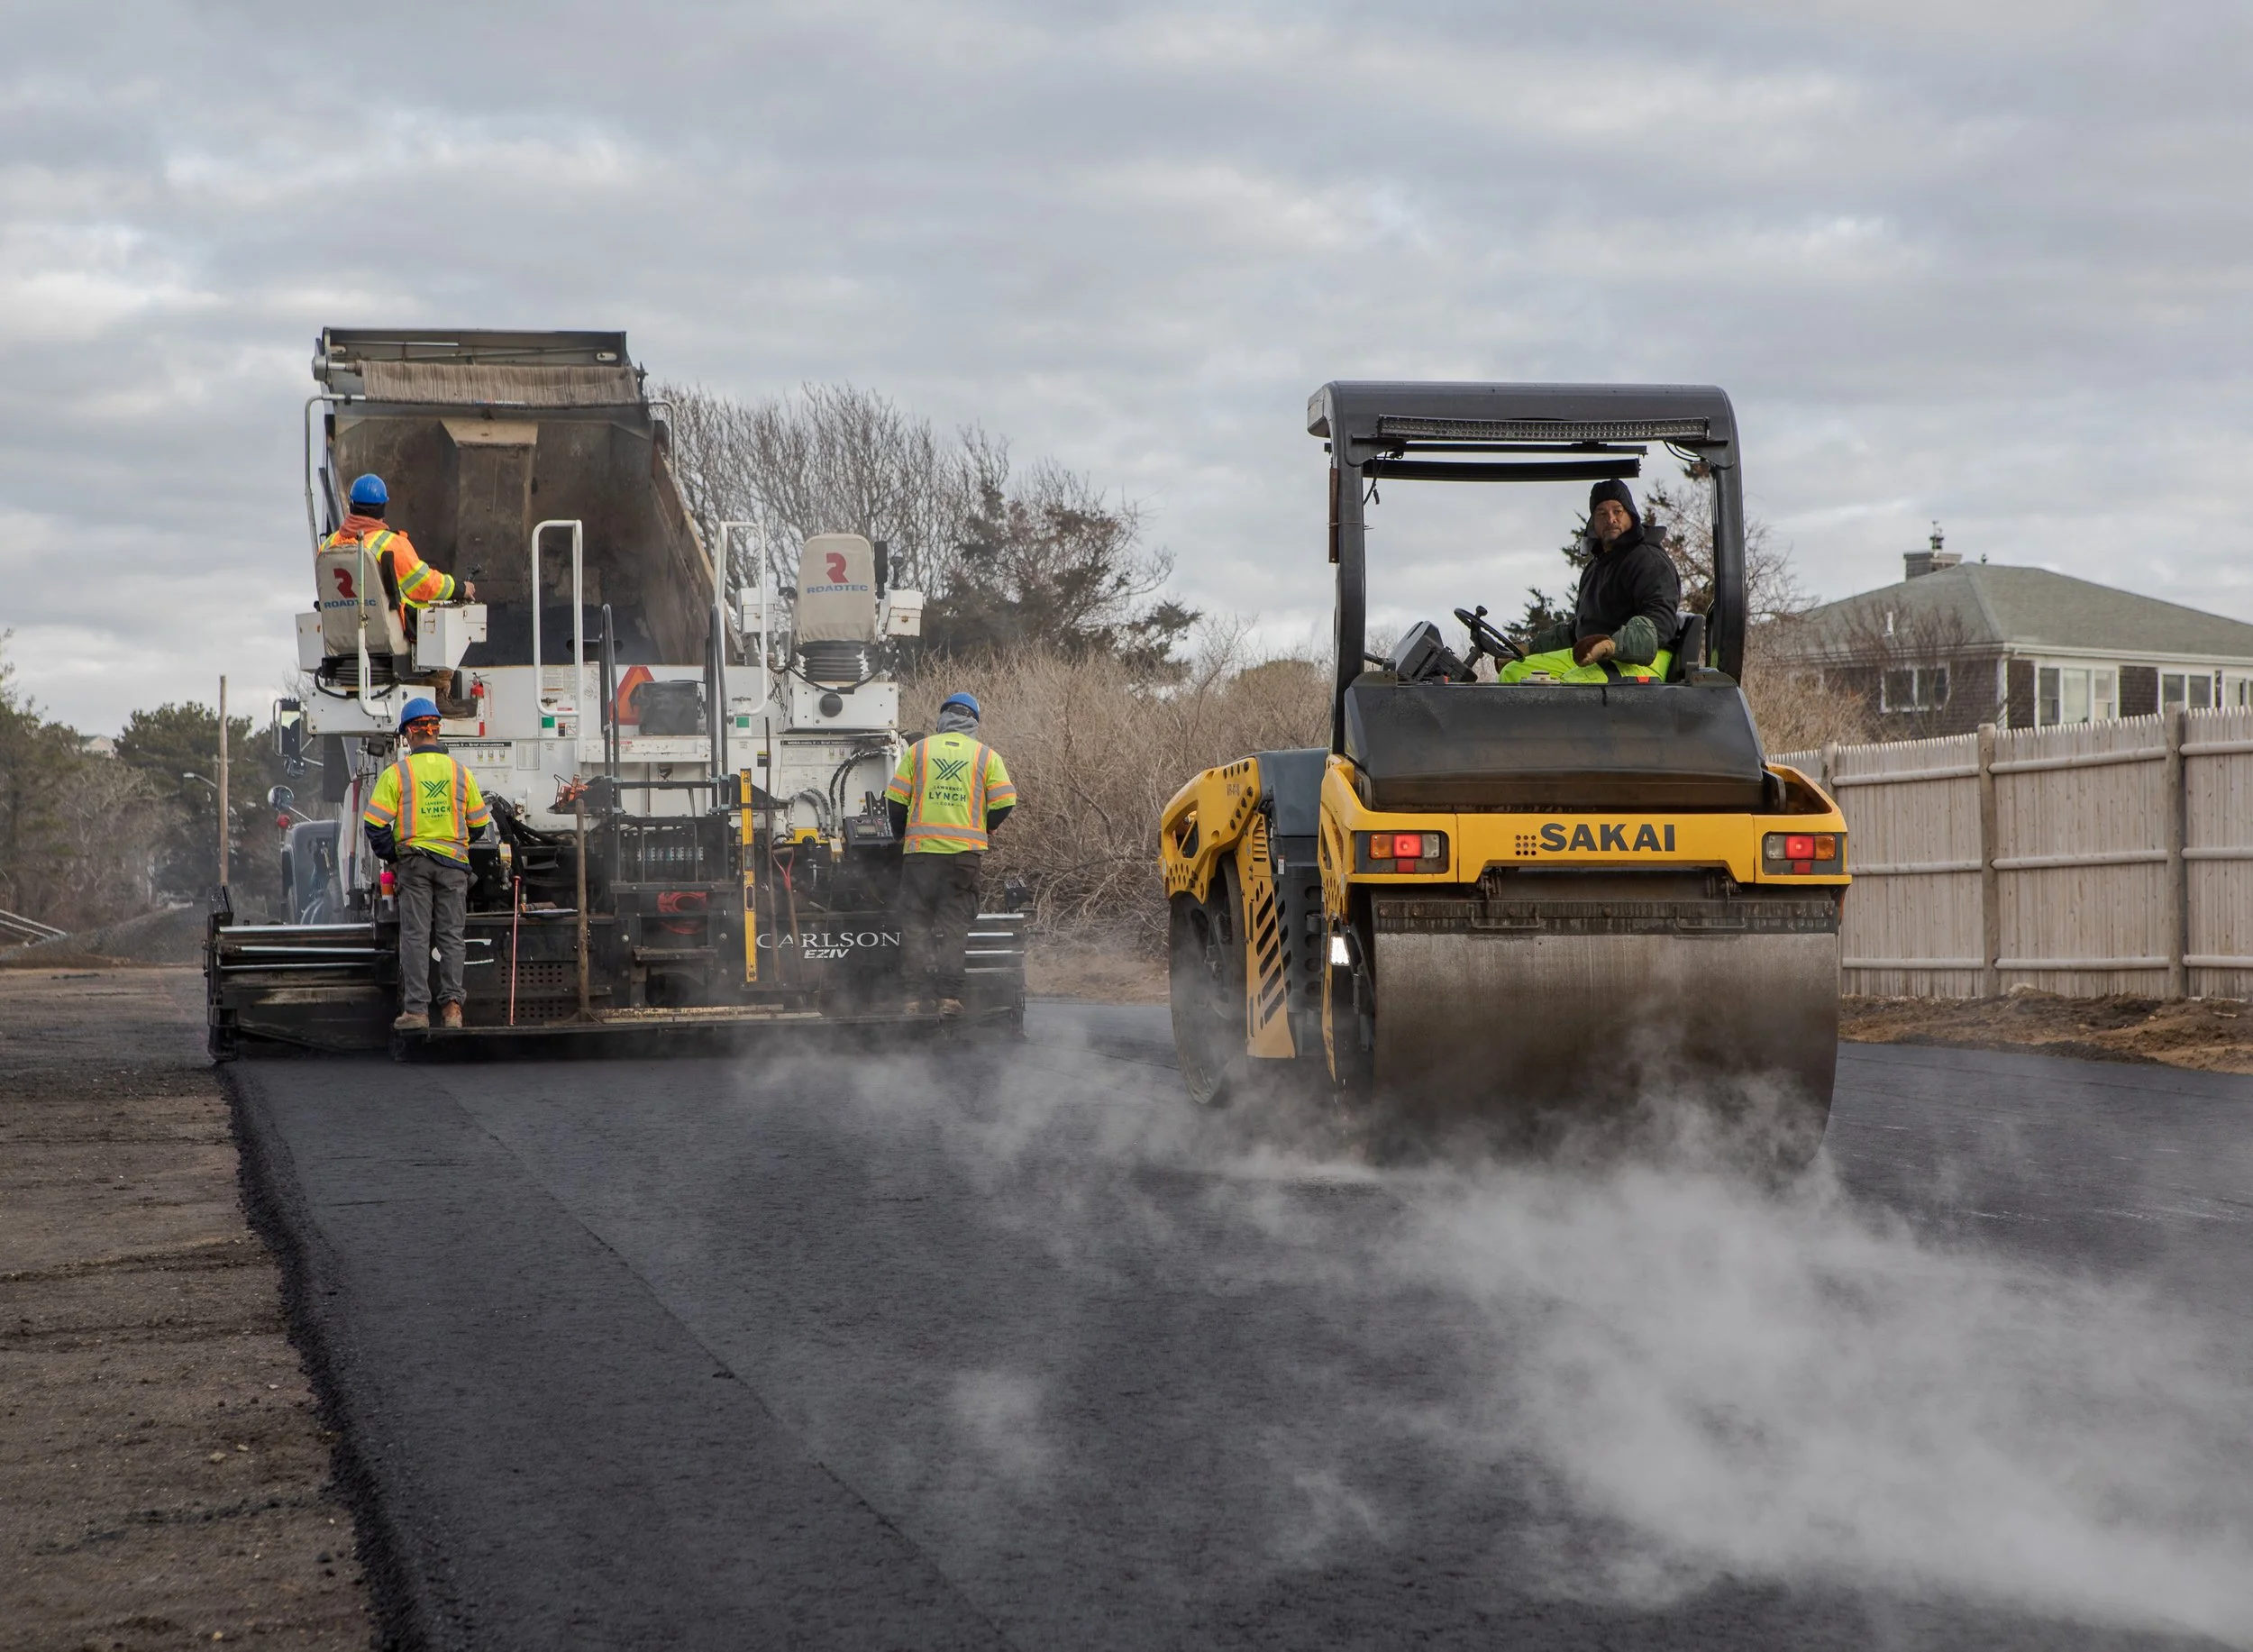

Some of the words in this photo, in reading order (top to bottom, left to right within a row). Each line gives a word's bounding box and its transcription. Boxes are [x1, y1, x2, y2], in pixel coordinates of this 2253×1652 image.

[807, 584, 869, 594] ROADTEC
[928, 792, 966, 802] LYNCH
[421, 806, 451, 814] LYNCH
[1539, 823, 1675, 852] SAKAI
[756, 932, 901, 948] CARLSON
[804, 948, 849, 959] EZIV
